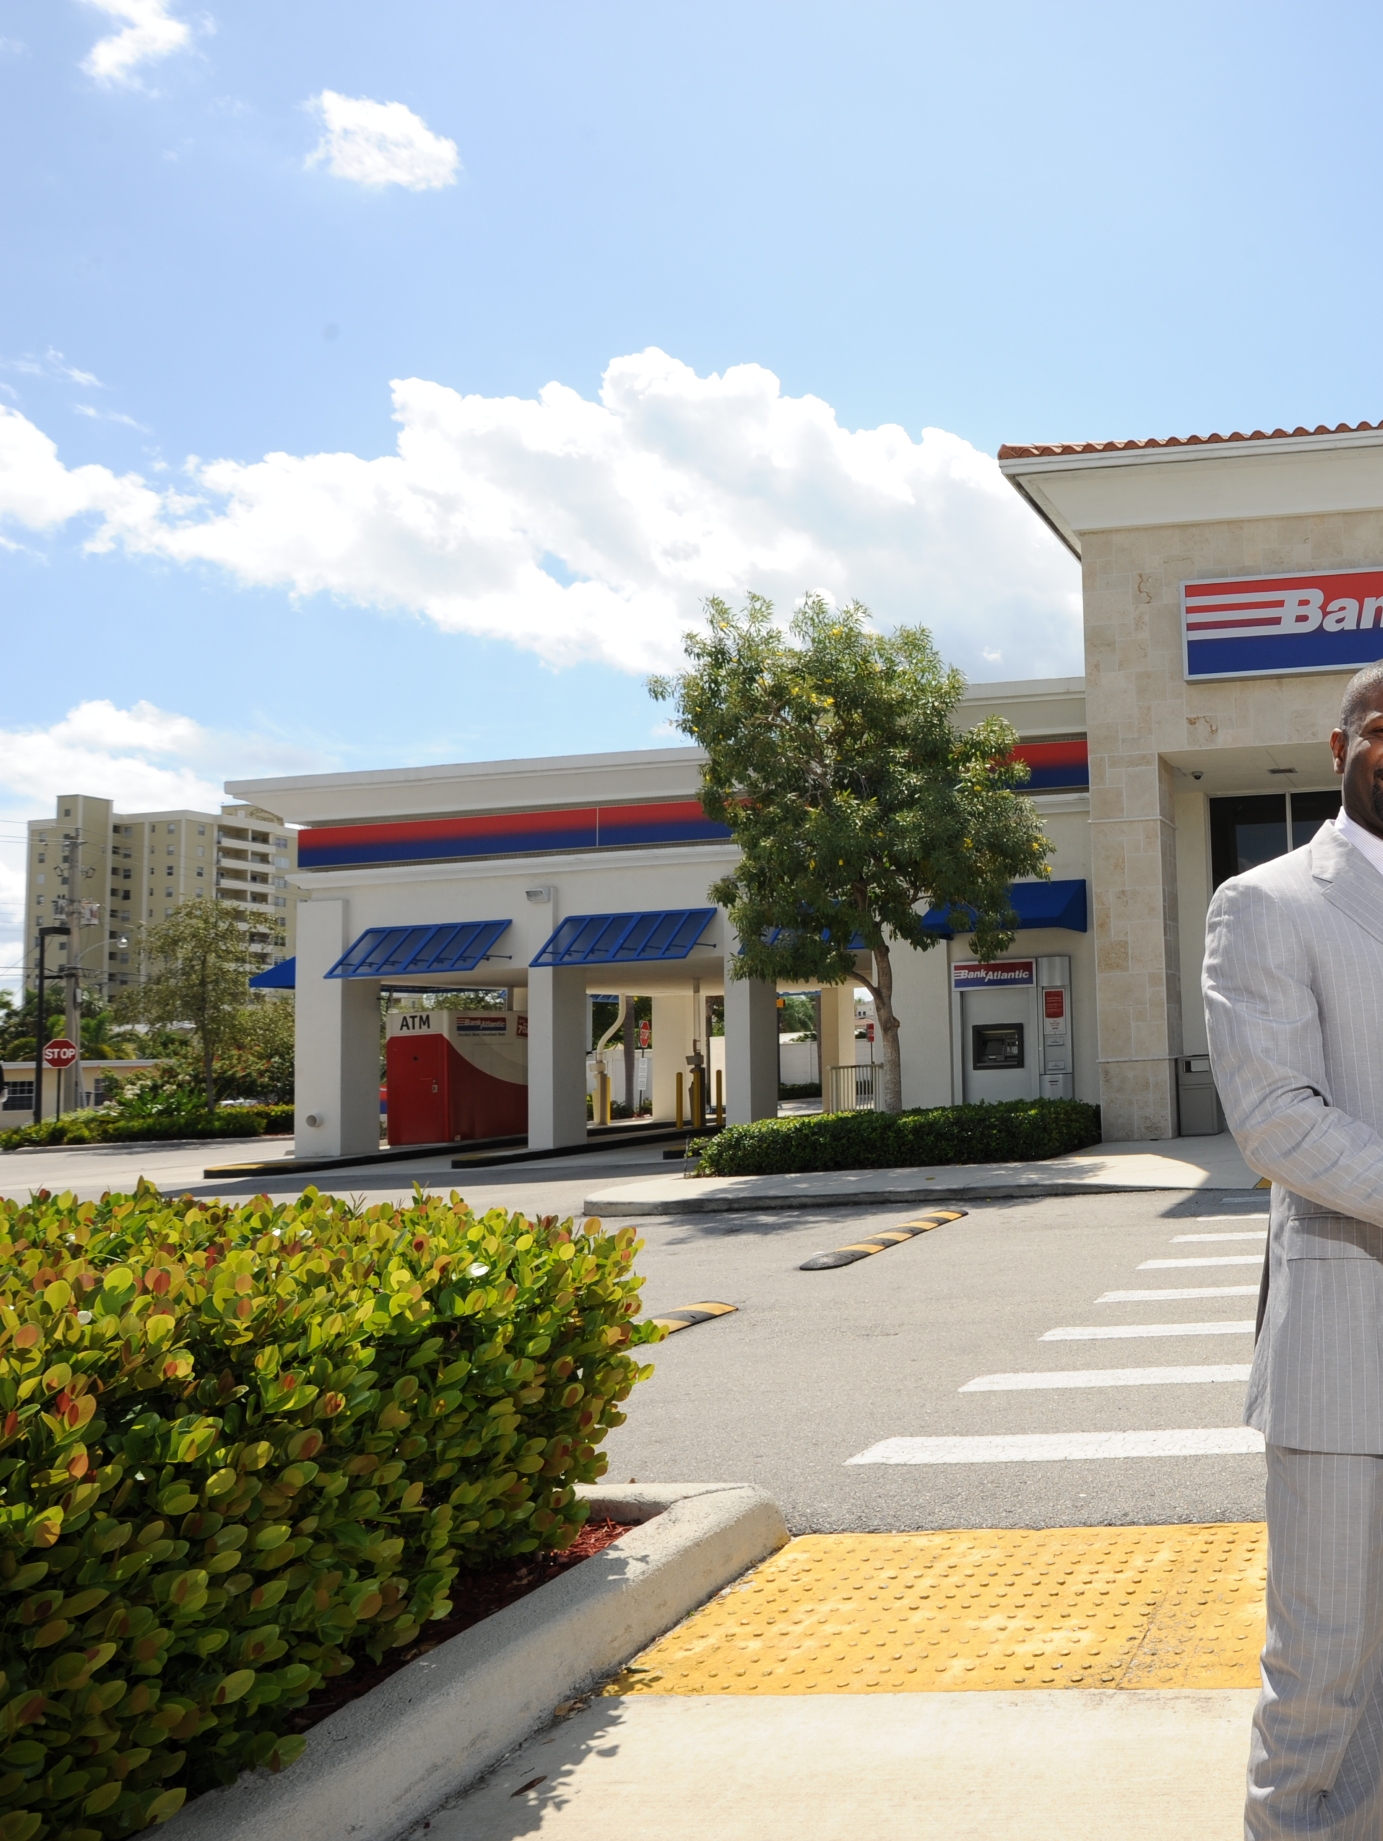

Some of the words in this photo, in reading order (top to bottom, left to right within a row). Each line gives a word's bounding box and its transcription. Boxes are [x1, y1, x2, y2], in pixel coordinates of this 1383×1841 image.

[960, 969, 1030, 983] BankAtlantic
[400, 1014, 431, 1030] ATM
[465, 1019, 506, 1029] BankAtlantic
[44, 1048, 76, 1059] STOP
